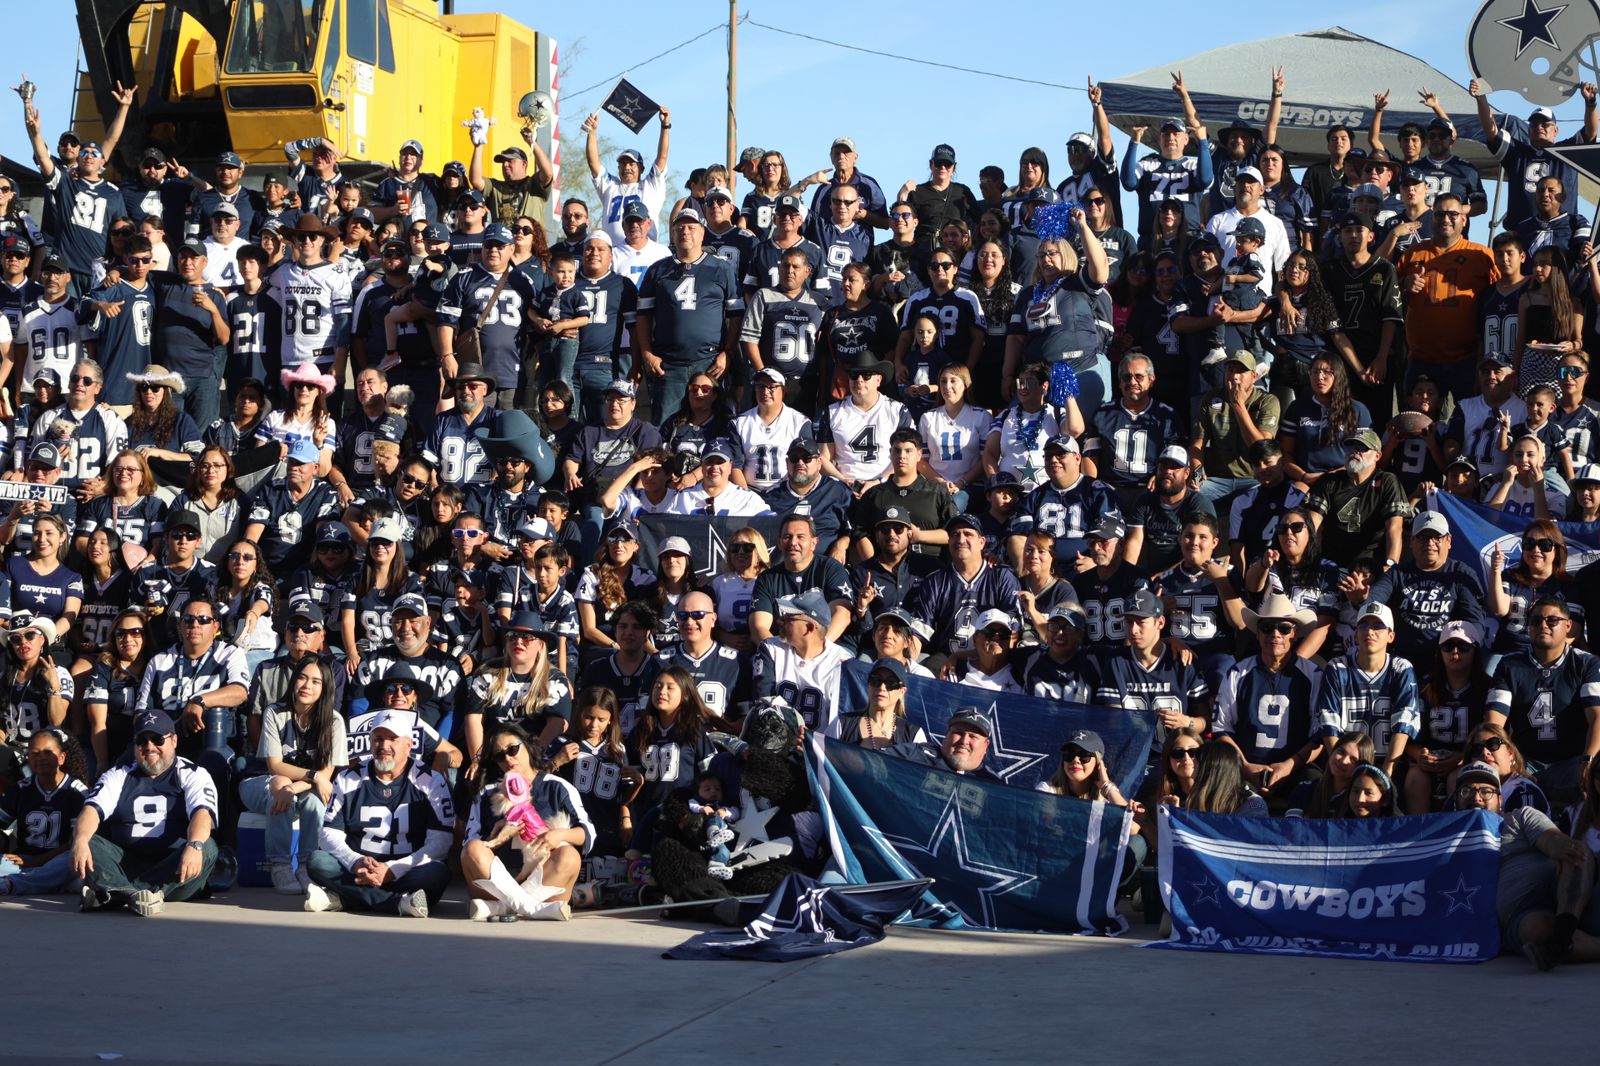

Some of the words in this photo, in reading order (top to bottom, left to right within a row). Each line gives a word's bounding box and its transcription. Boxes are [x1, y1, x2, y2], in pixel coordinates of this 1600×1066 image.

[1150, 172, 1190, 202] 72
[221, 268, 238, 287] 4
[827, 244, 855, 286] 9
[285, 286, 322, 296] COWBOYS
[474, 286, 523, 328] 33
[674, 277, 698, 311] 4
[1343, 289, 1366, 329] 7
[233, 312, 266, 354] 21
[285, 300, 322, 336] 88
[784, 314, 809, 322] COWBOYS
[831, 315, 878, 334] DALLAS
[1485, 314, 1520, 352] 60
[31, 327, 69, 361] 60
[774, 321, 817, 364] 60
[836, 343, 869, 355] COWBOYS
[1156, 323, 1181, 355] 4
[441, 436, 493, 483] 82
[755, 443, 786, 481] 11
[850, 424, 879, 464] 4
[940, 431, 962, 461] 11
[1113, 428, 1148, 475] 11
[1403, 439, 1427, 473] 9
[44, 488, 64, 499] AVE
[1038, 502, 1086, 539] 81
[1334, 497, 1361, 533] 4
[20, 584, 62, 595] COWBOYS
[1412, 600, 1452, 613] LOCK
[1085, 597, 1127, 642] 88
[1170, 595, 1218, 640] 55
[1126, 681, 1171, 693] DALLAS
[1255, 694, 1290, 749] 9
[1341, 696, 1392, 756] 52
[1429, 705, 1469, 744] 21
[1527, 690, 1558, 741] 4
[572, 751, 622, 801] 88
[25, 810, 62, 849] 21
[131, 795, 168, 838] 9
[359, 803, 413, 856] 21
[1226, 879, 1427, 919] COWBOYS
